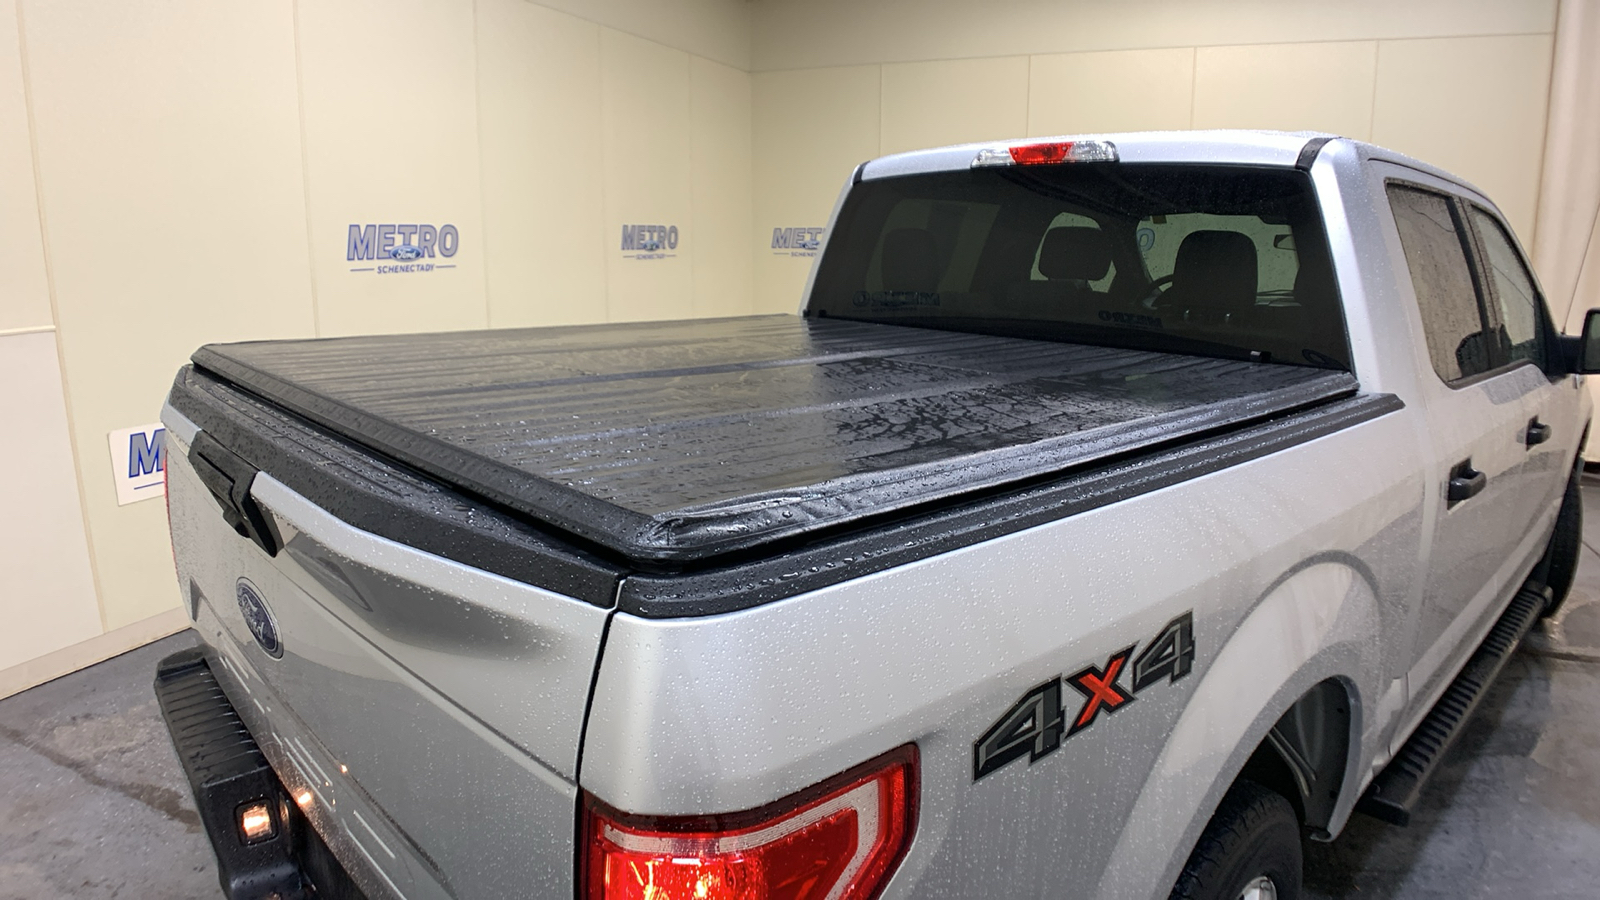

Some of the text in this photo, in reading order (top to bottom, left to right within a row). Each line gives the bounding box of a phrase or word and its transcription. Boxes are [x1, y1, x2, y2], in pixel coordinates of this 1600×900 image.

[347, 224, 459, 261] METRO
[621, 225, 678, 250] METRO
[771, 227, 827, 249] MET
[377, 264, 435, 274] SCHENECTADY
